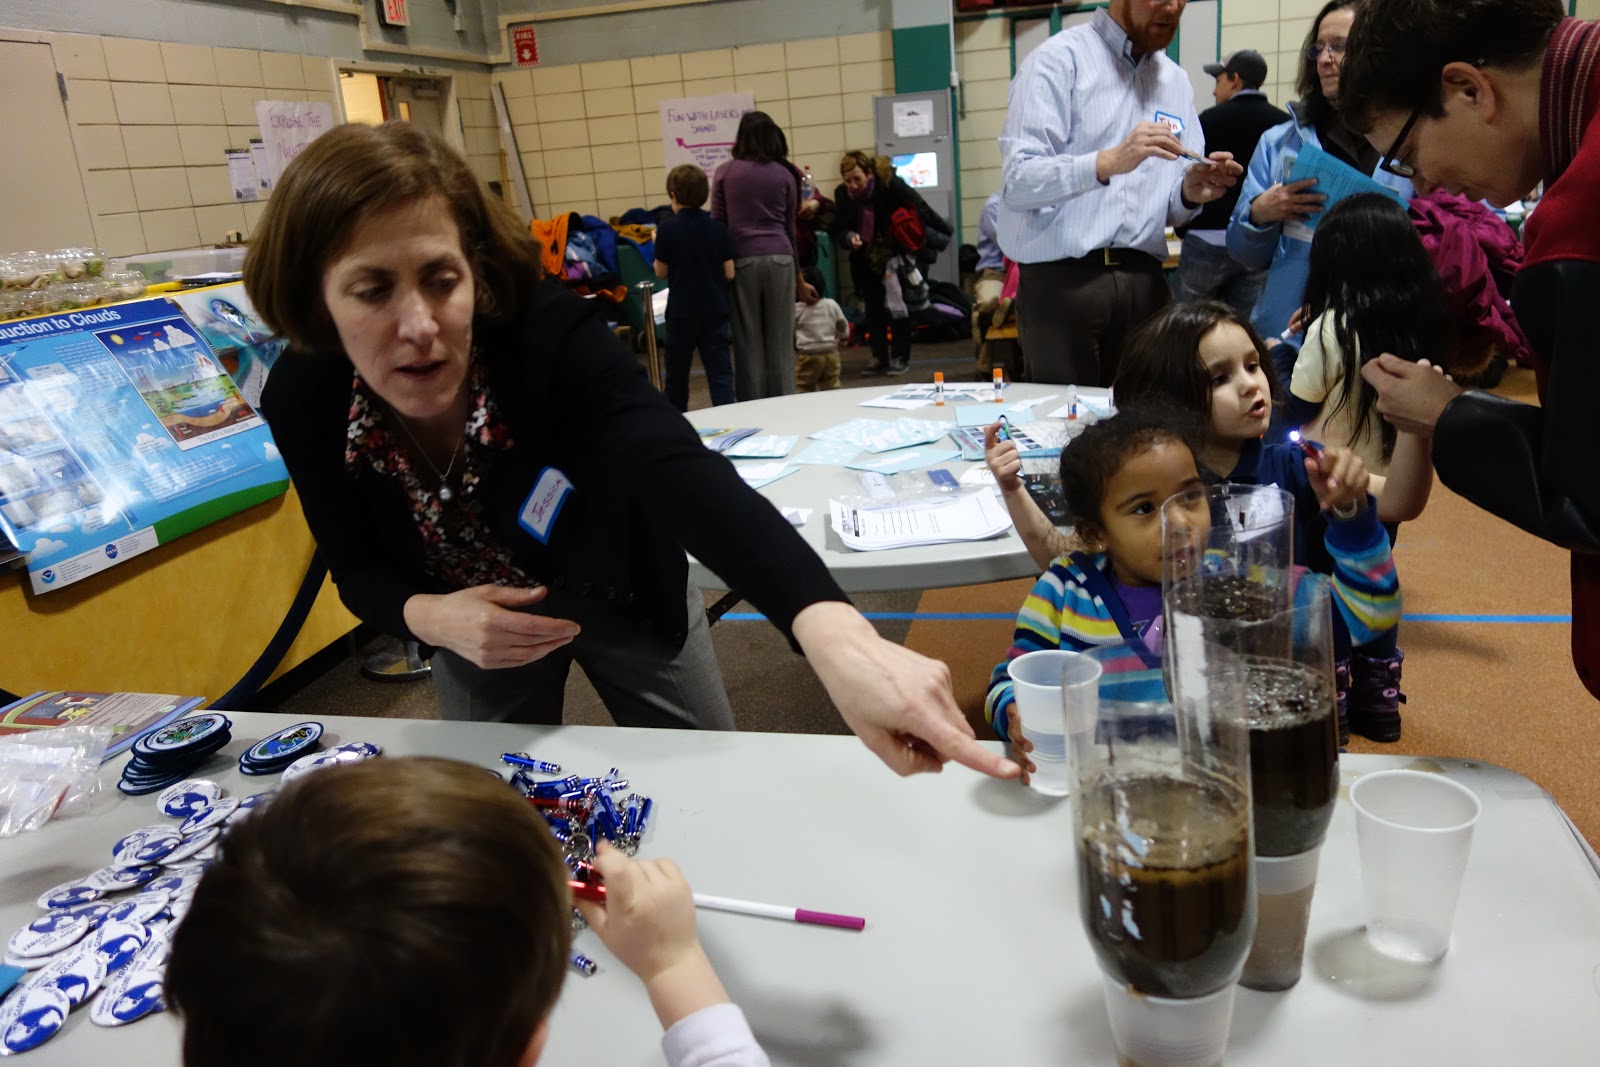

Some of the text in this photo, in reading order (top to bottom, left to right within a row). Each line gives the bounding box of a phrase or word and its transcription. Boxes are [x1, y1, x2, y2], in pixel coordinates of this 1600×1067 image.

[386, 0, 406, 22] EXIT
[516, 31, 533, 40] FIRE
[304, 111, 322, 128] THE
[667, 108, 685, 123] FUN
[686, 110, 708, 122] WITH
[710, 109, 740, 120] LASERS
[691, 123, 716, 134] SOUND
[50, 317, 71, 329] to
[69, 309, 121, 326] Clouds
